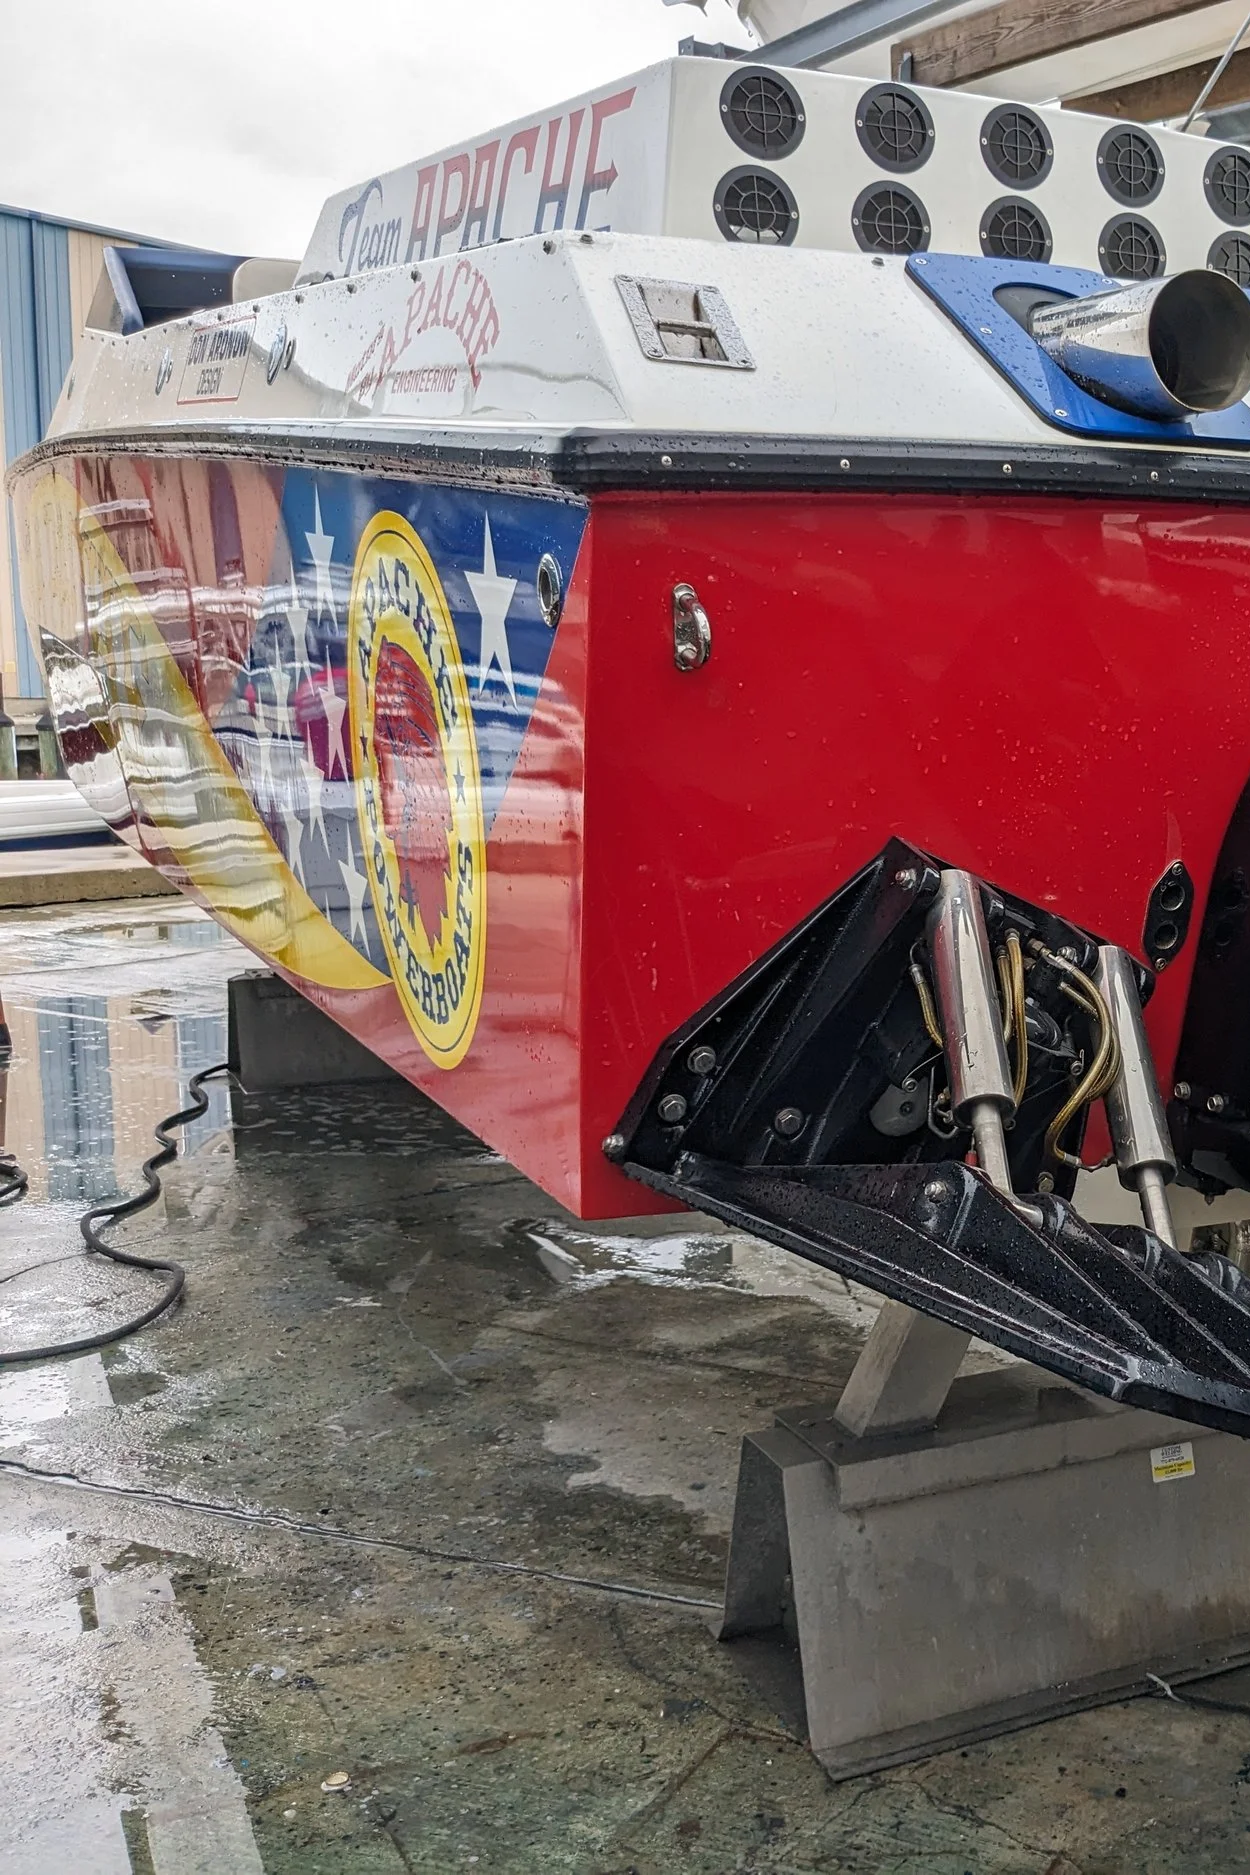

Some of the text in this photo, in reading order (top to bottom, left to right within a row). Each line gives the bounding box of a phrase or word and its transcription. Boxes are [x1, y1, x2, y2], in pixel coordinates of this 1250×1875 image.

[338, 87, 637, 277] Team APACHE
[372, 259, 500, 400] APACHE
[391, 366, 458, 394] ENGINEERING
